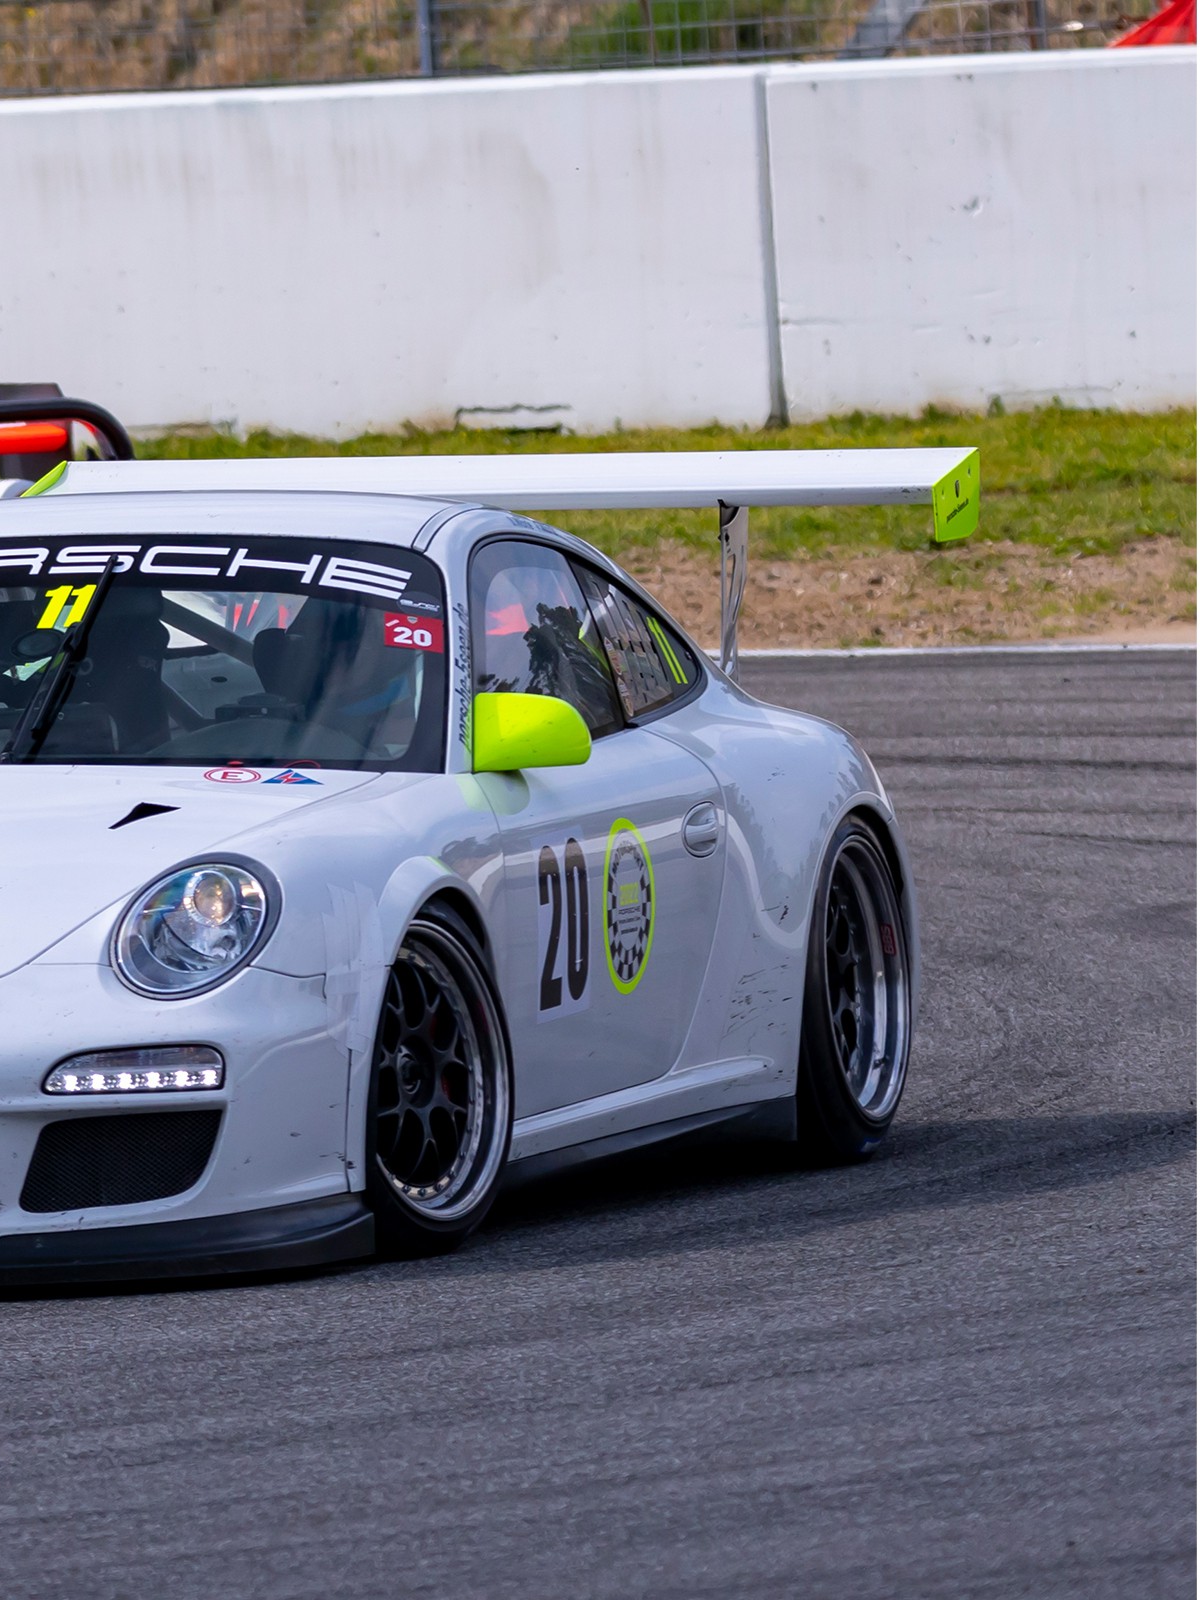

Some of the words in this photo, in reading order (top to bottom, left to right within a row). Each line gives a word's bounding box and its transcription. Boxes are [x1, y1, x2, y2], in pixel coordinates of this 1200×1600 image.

[36, 584, 97, 629] 11
[452, 602, 472, 753] porsche-5seende
[221, 771, 244, 781] E
[538, 837, 589, 1011] 20
